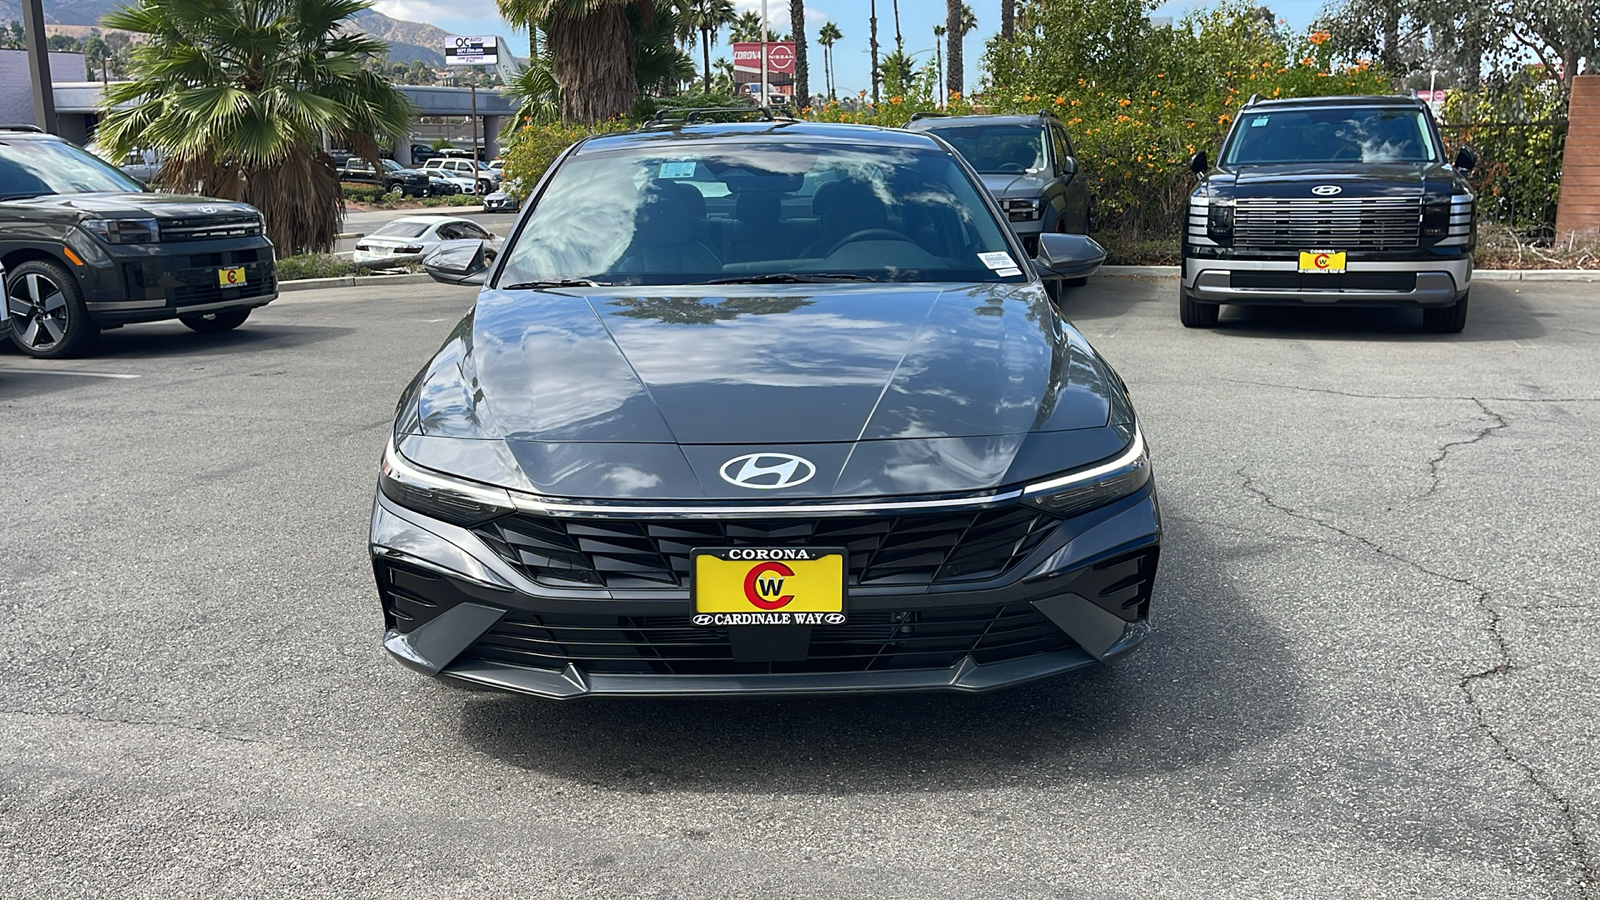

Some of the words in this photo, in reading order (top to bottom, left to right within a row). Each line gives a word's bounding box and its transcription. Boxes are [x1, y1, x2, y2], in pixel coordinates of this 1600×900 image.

[456, 37, 470, 47] OC
[734, 51, 761, 59] CORONA
[728, 549, 810, 560] CORONA
[714, 613, 791, 625] CARDINALE
[794, 613, 825, 625] WAY
